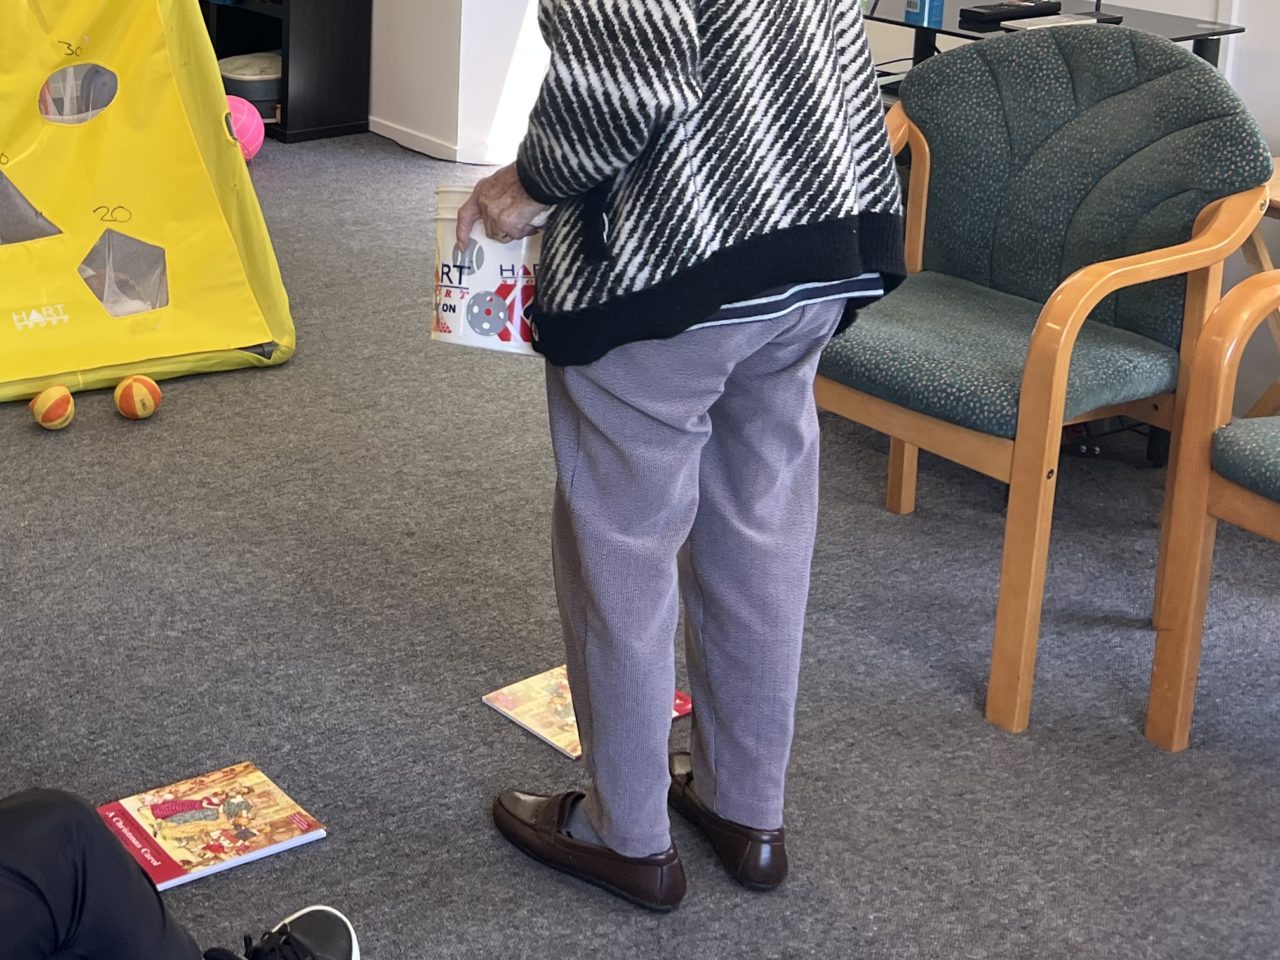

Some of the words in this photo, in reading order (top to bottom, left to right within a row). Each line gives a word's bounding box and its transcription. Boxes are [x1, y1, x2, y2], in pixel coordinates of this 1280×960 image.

[57, 40, 83, 56] 30
[92, 205, 132, 223] 20
[442, 303, 456, 313] ON
[112, 816, 142, 849] Christmas
[140, 848, 162, 866] Carol
